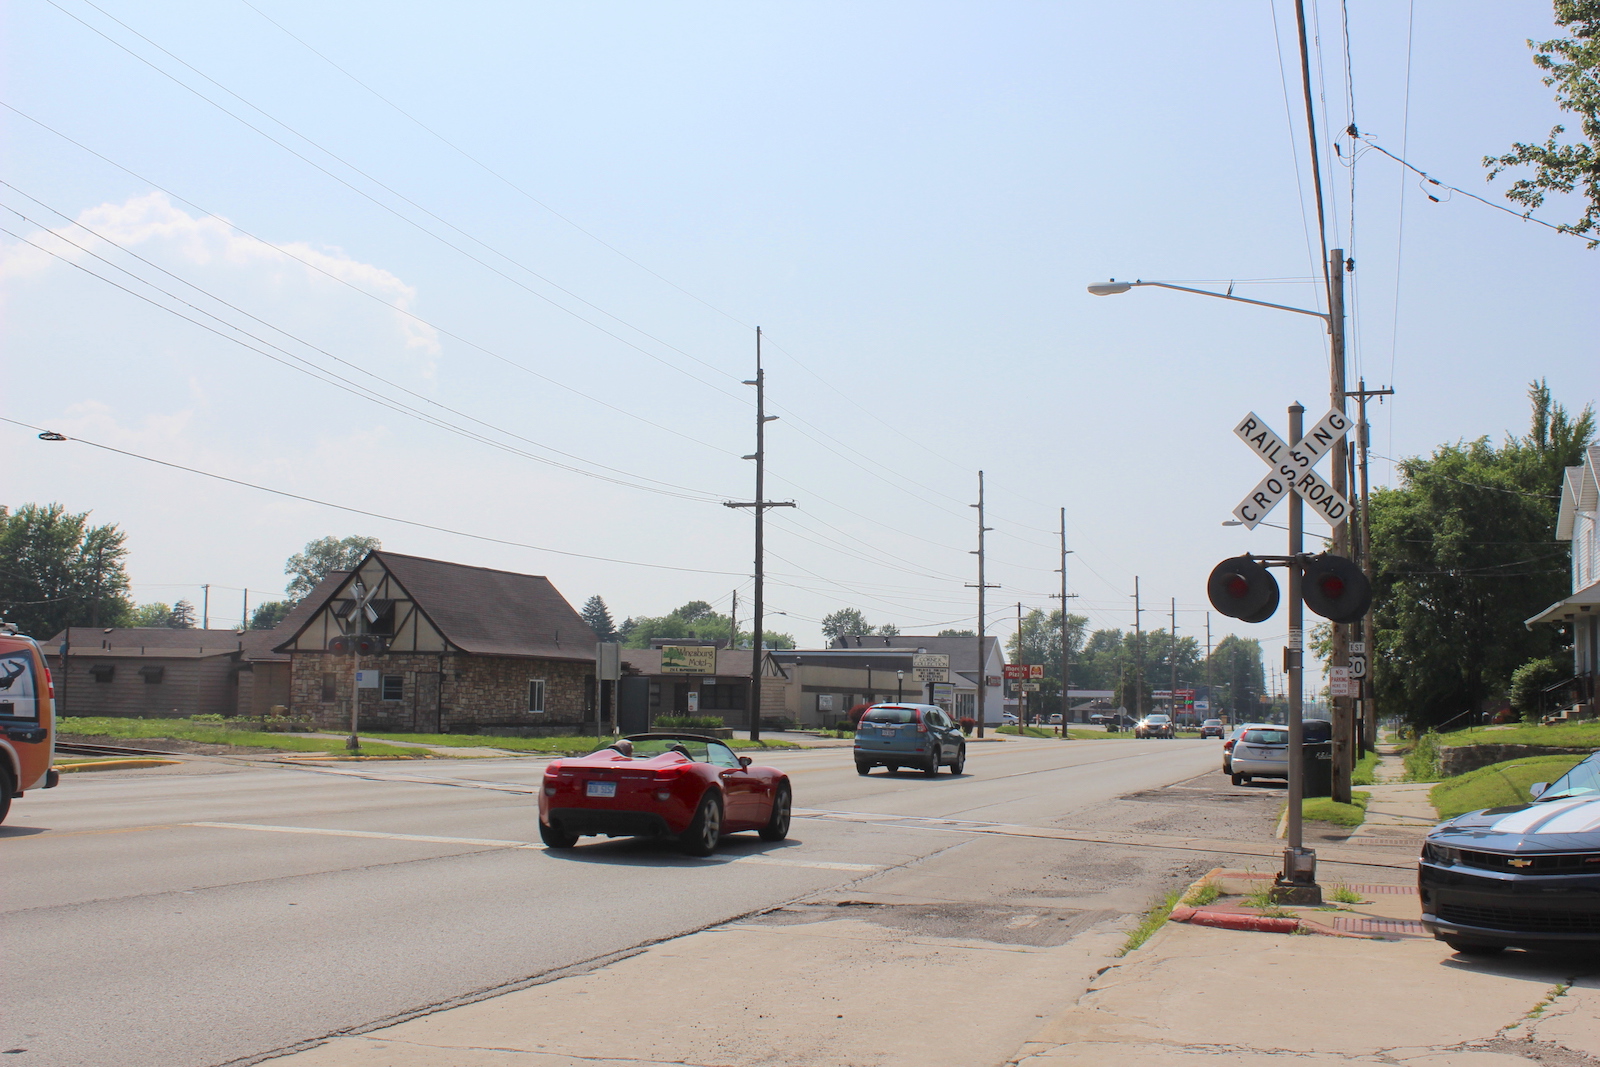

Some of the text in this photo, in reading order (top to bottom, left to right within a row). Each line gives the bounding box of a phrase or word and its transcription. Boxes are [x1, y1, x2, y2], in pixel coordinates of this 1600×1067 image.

[1239, 417, 1345, 520] RAIL ROAD
[1240, 414, 1346, 522] CROSSING
[677, 647, 713, 659] Winesburg
[688, 658, 713, 668] Motel
